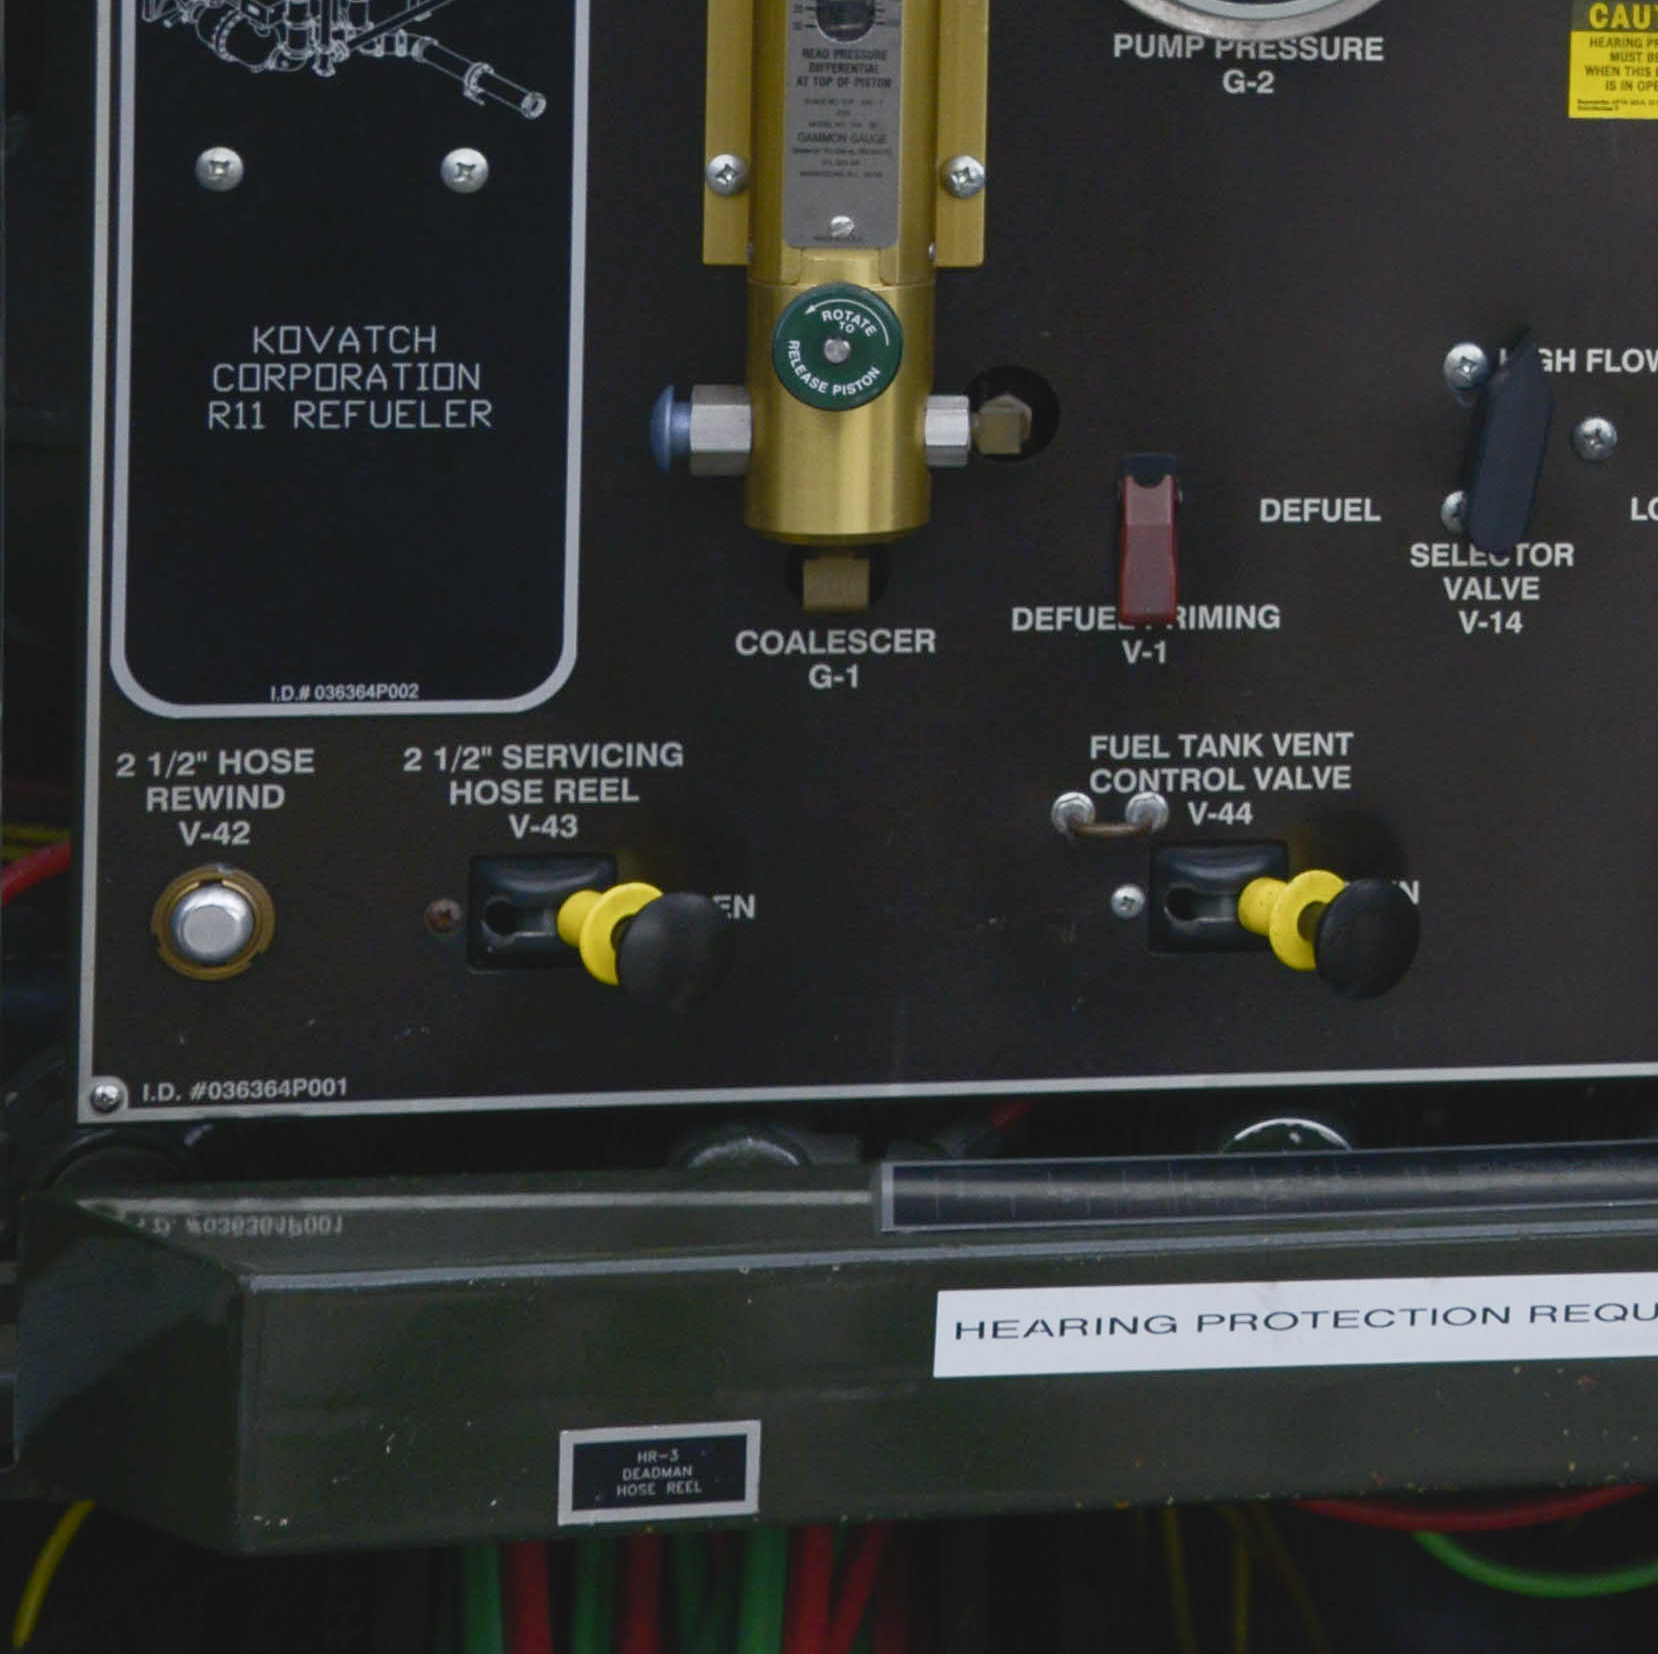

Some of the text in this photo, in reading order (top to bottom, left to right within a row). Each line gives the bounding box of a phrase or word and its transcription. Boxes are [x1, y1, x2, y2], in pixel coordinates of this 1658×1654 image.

[833, 49, 887, 62] PRESSURE
[1113, 34, 1385, 62] PUMP PRESSURE
[1589, 37, 1643, 49] HEARING
[808, 62, 880, 75] DIFFERENTIAL
[1609, 52, 1643, 63] MUST
[813, 76, 834, 88] TOP
[837, 76, 851, 88] OF
[853, 77, 893, 89] PISTON
[1222, 70, 1275, 95] G-2
[1585, 66, 1620, 77] WHEN
[1624, 66, 1652, 77] THIS
[821, 309, 878, 338] ROTATE
[253, 325, 438, 355] KOVATCH
[212, 362, 482, 393] CORPORATION
[788, 339, 881, 397] RELEASE PISTON
[208, 399, 494, 430] R11 REFUELER
[1259, 498, 1382, 523] DEFUEL
[1443, 576, 1541, 601] VALVE
[1011, 607, 1135, 631] DEFUE
[1459, 610, 1524, 635] V-14
[735, 629, 936, 656] COALESCER
[1122, 640, 1168, 664] V-1
[808, 665, 860, 689] G-1
[402, 742, 685, 773] 2 1/2" SERVICING
[1089, 732, 1355, 760] FUEL TANK VENT
[116, 748, 316, 778] 2 1/2" HOSE
[449, 777, 640, 807] HOSE REEL
[1089, 765, 1352, 794] CONTROL VALVE
[145, 784, 287, 811] REWIND
[508, 813, 579, 839] V-43
[1187, 801, 1254, 826] V-44
[178, 820, 252, 847] V-42
[141, 1076, 349, 1103] I.D. #036364P001
[953, 1313, 1180, 1341] HEARING
[1195, 1303, 1513, 1335] PROTECTION
[637, 1448, 680, 1464] HR-3
[622, 1464, 694, 1481] DEADMAN
[616, 1479, 703, 1498] HOSE REEL
